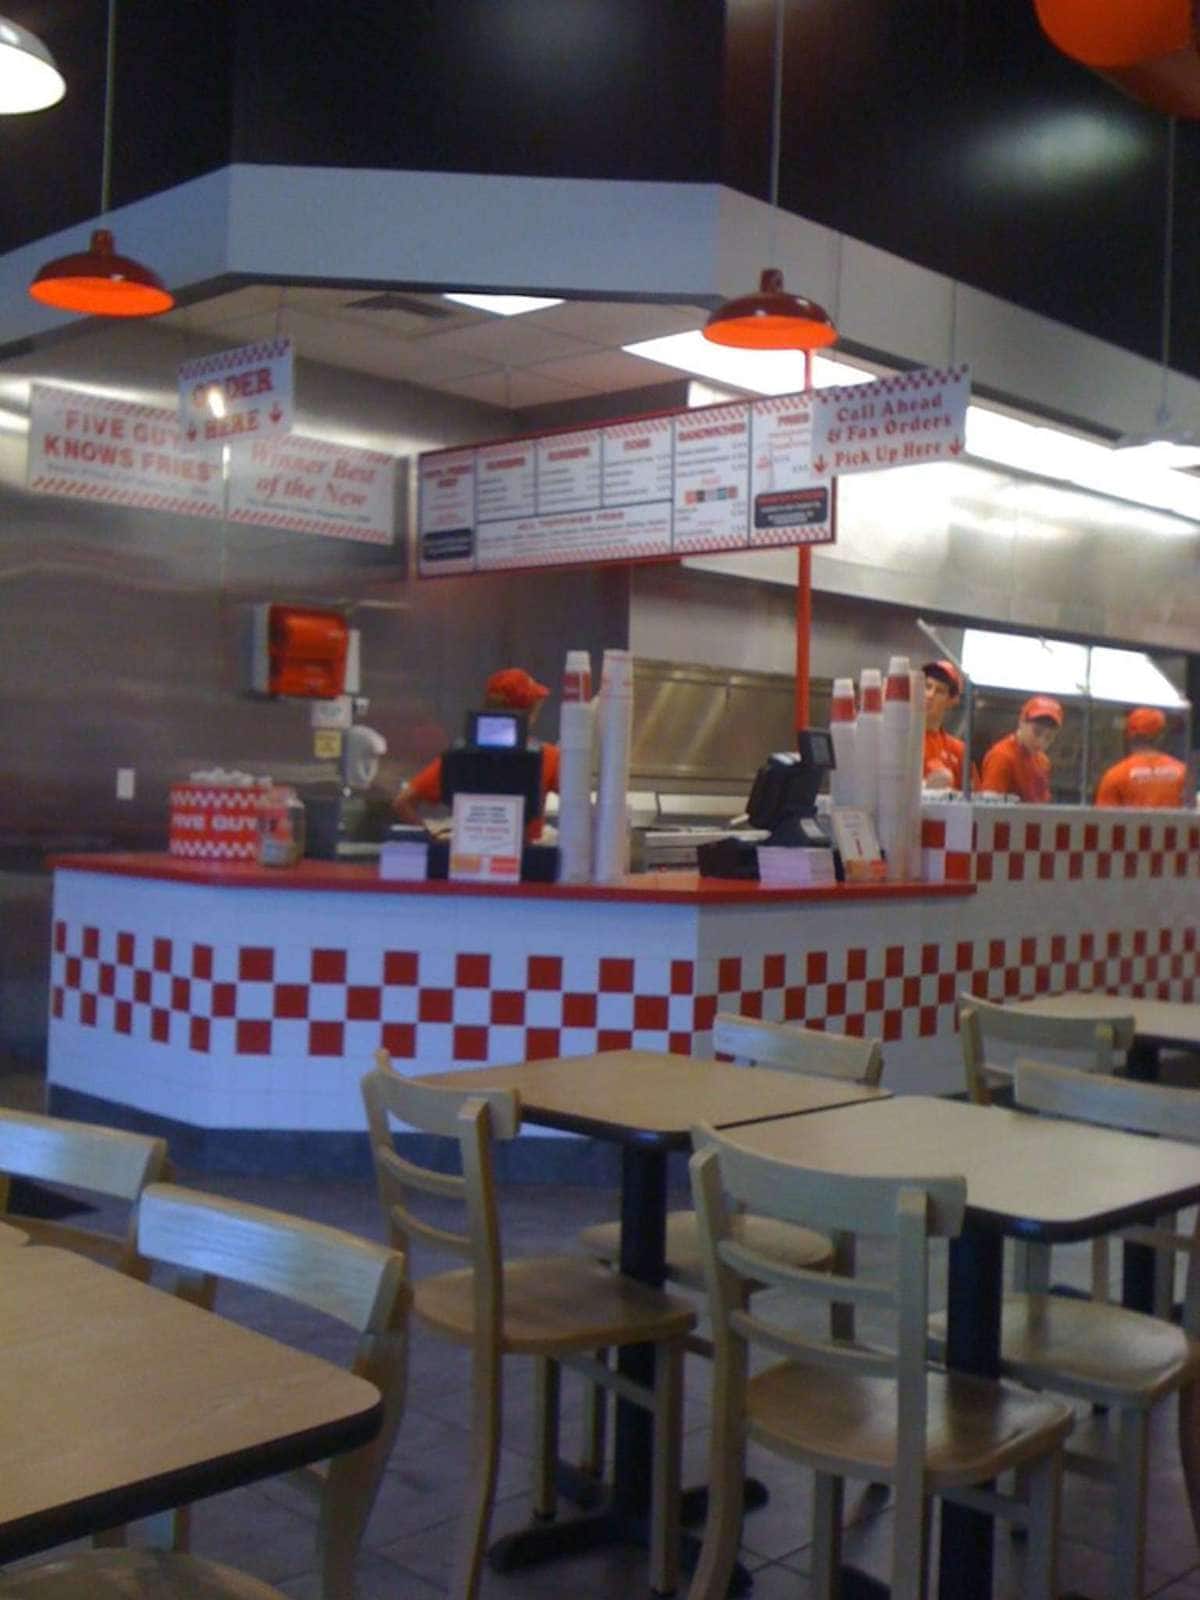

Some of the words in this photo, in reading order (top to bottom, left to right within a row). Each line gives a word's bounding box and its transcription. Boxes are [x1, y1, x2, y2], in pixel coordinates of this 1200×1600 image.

[191, 367, 273, 409] ODER
[836, 403, 875, 422] Call
[882, 392, 943, 416] Ahead
[66, 410, 125, 440] FIVE
[134, 422, 179, 447] GUY
[848, 425, 878, 441] Fax
[884, 414, 952, 436] Orders
[44, 433, 134, 468] KNOWS
[834, 451, 871, 467] Pick
[875, 446, 898, 463] Up
[903, 440, 941, 458] Here
[212, 814, 258, 832] GUY
